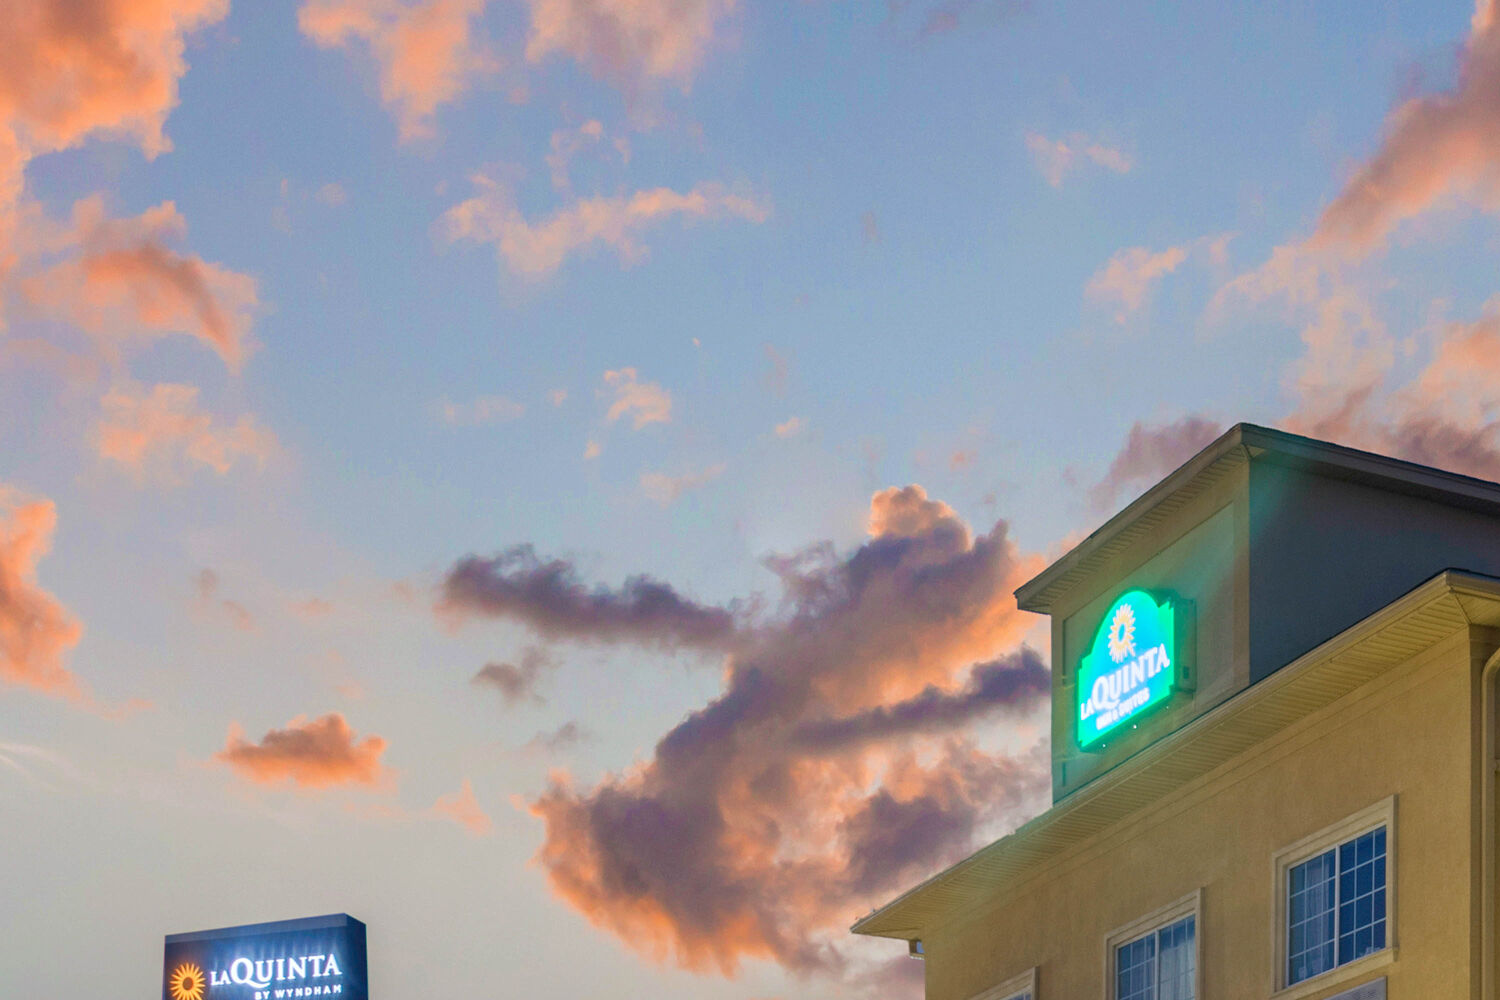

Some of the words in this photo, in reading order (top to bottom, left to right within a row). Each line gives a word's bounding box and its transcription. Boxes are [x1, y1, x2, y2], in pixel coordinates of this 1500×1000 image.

[1092, 643, 1170, 710] QUINTA
[230, 953, 343, 989] QUINTA
[254, 990, 271, 1000] BY
[274, 984, 342, 999] WYNDHAM
